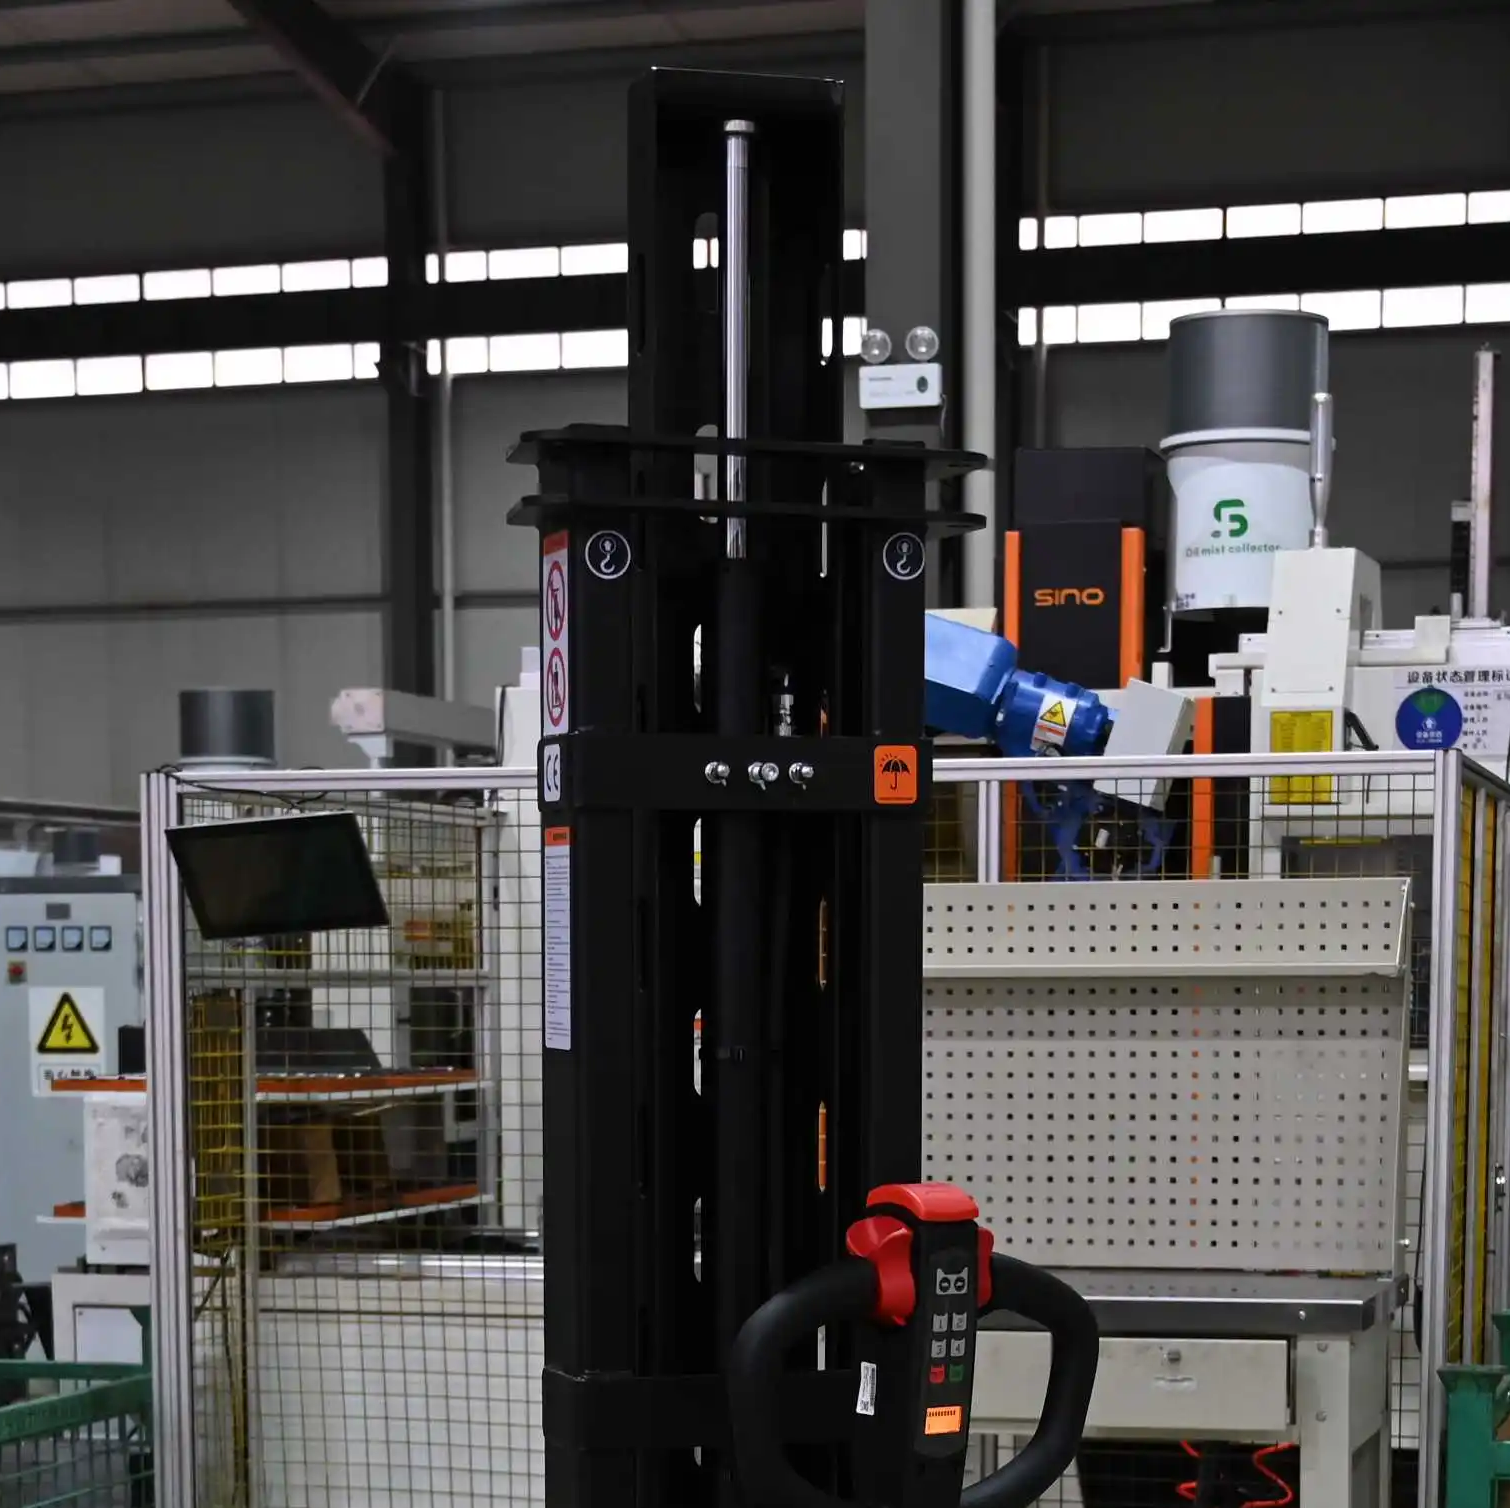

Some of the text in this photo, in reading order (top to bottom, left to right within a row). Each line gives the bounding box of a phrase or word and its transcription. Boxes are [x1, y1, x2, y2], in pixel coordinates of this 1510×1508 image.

[1201, 545, 1225, 557] mist
[1228, 543, 1281, 554] collector
[546, 753, 559, 792] CE
